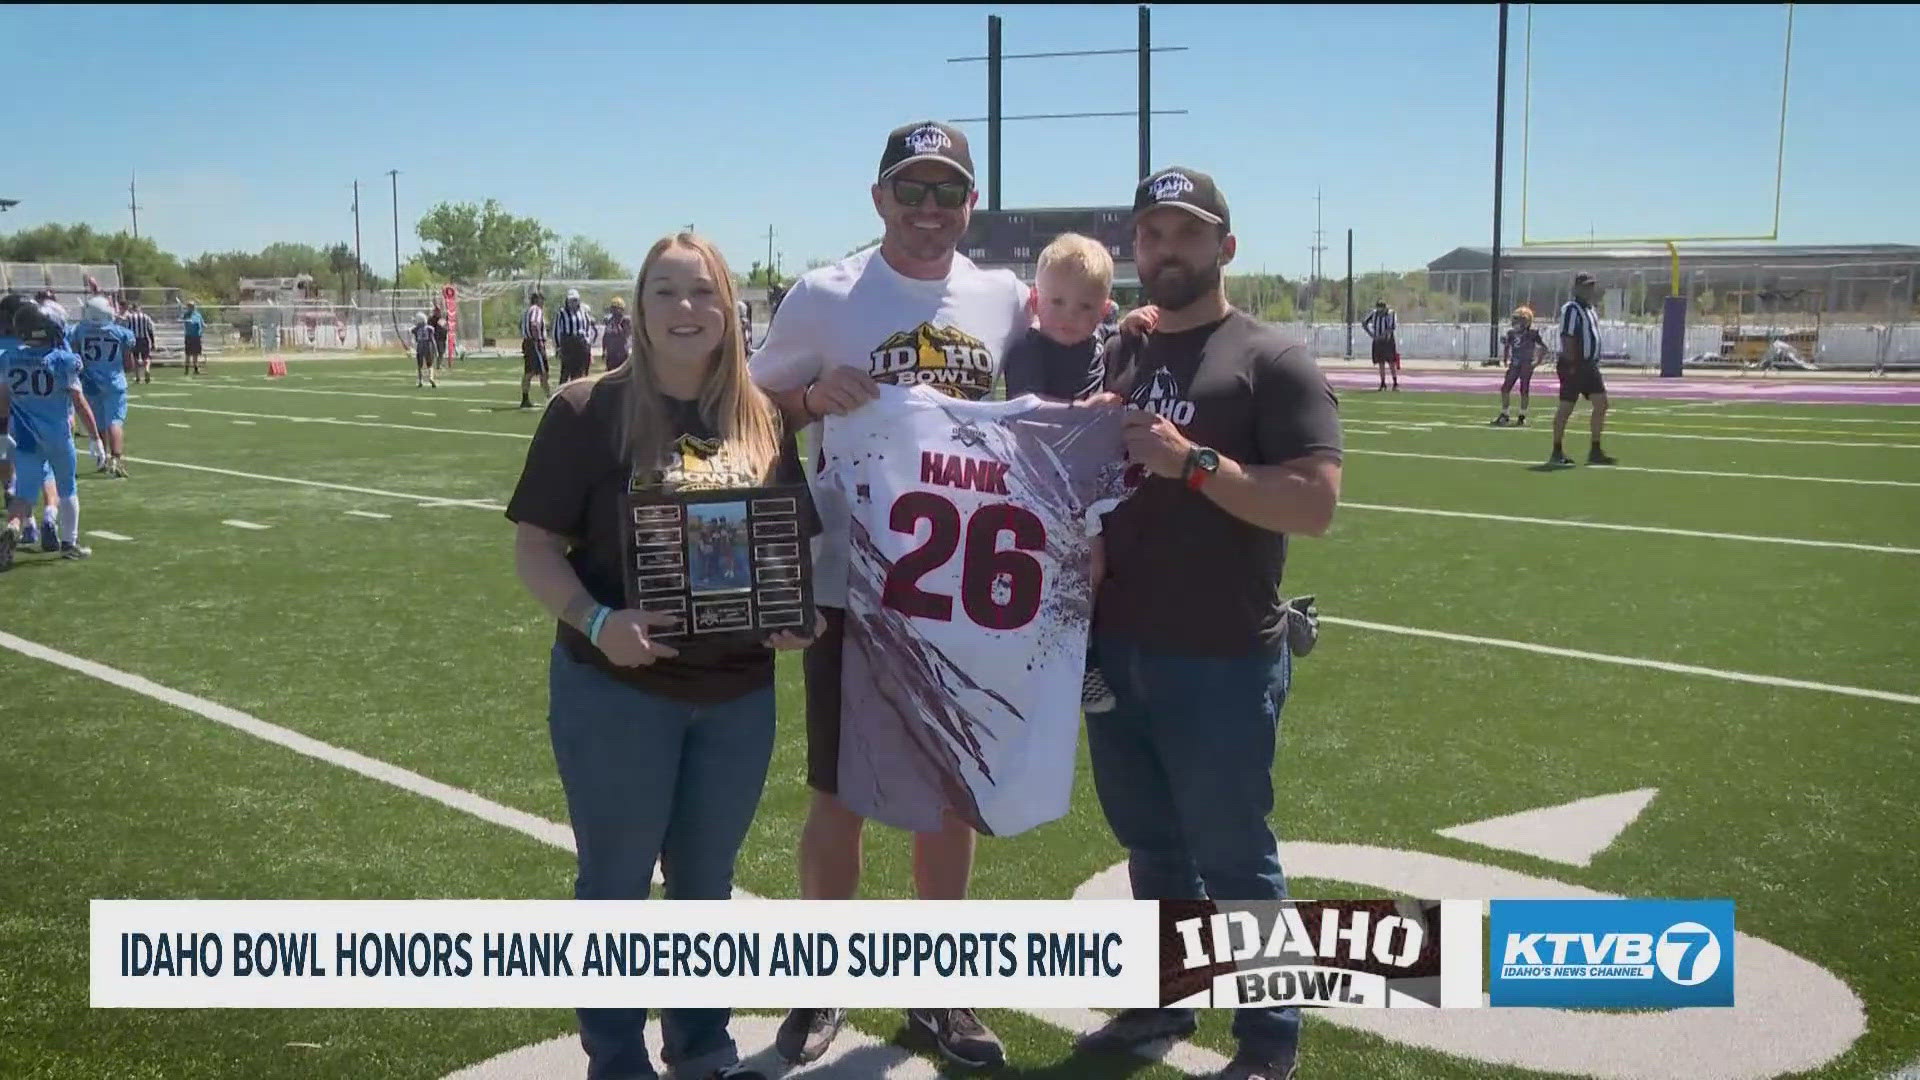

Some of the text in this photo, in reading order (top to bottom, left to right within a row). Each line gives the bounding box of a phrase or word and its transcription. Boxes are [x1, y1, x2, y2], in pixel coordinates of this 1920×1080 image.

[84, 336, 120, 362] 57
[8, 367, 54, 396] 20
[895, 368, 976, 385] BOWL
[1123, 398, 1195, 426] AHO
[920, 450, 1011, 495] HANK
[882, 491, 1046, 630] 26
